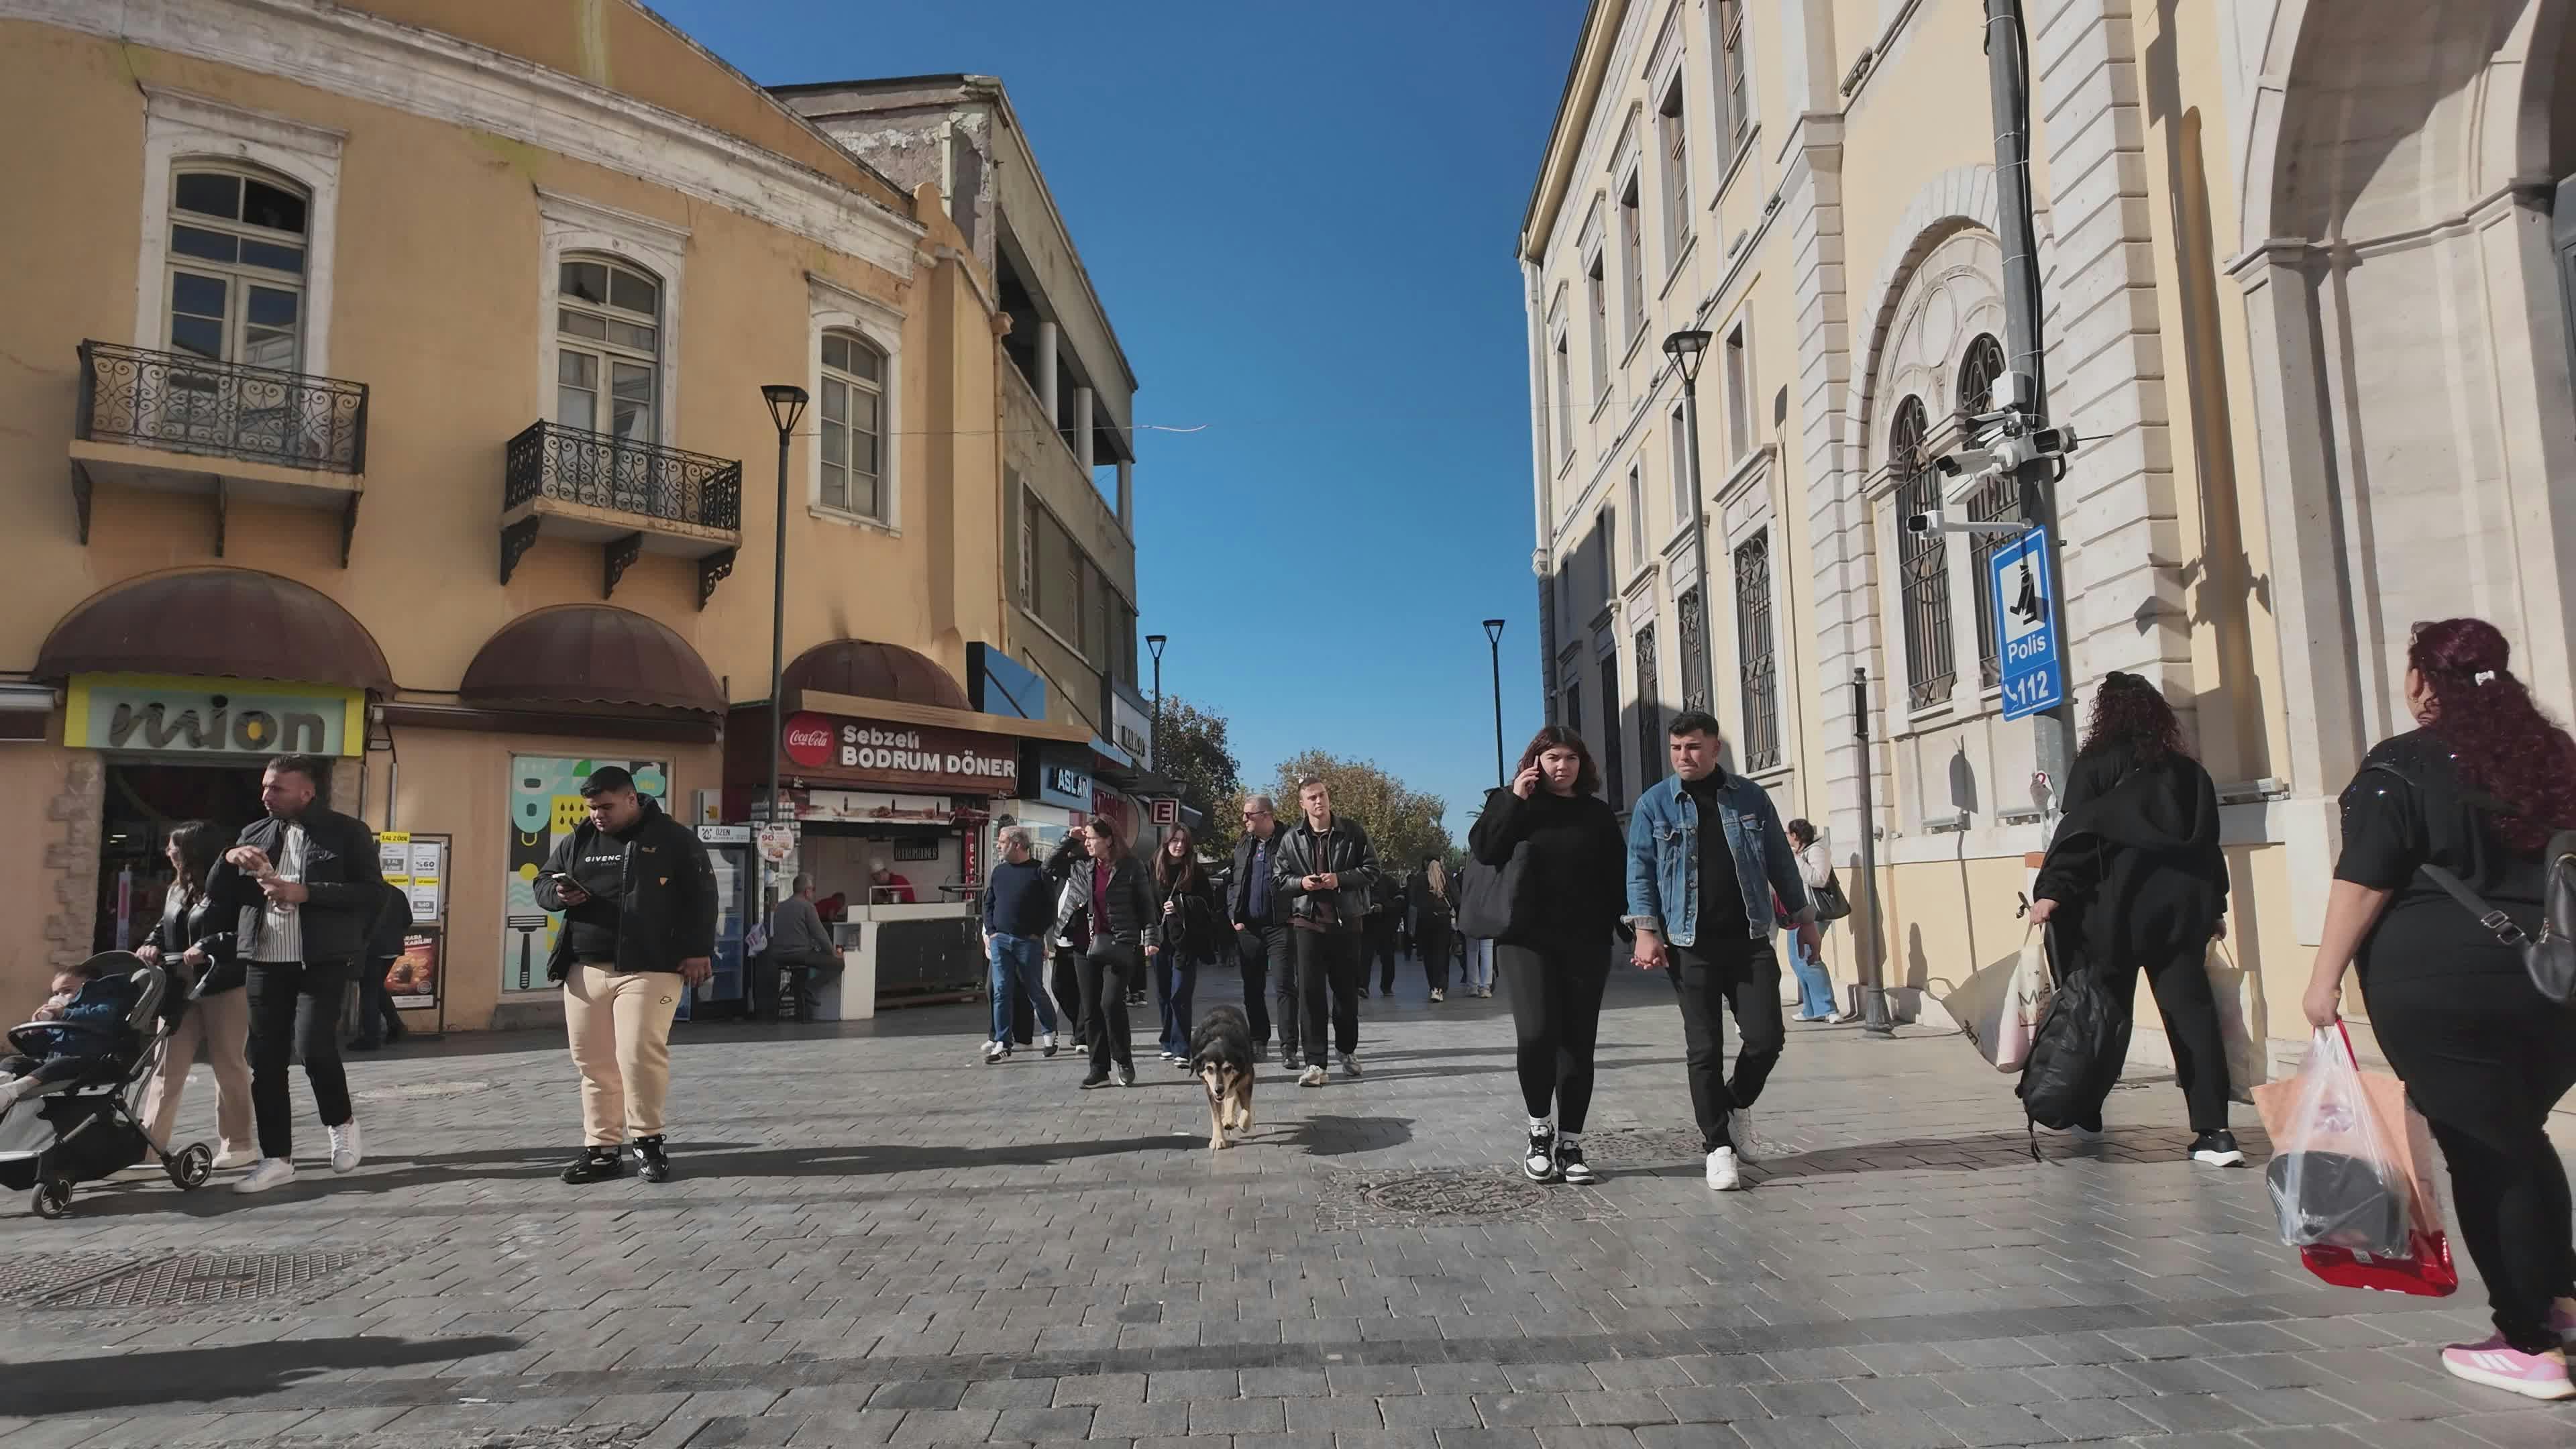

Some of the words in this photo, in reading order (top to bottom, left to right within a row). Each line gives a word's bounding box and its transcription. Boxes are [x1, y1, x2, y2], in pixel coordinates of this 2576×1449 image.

[2008, 634, 2046, 663] Polis
[2017, 670, 2049, 705] 112
[790, 729, 828, 747] Coca-Cola
[843, 724, 920, 749] Sebzeli
[842, 746, 941, 771] BODRUM
[947, 749, 1016, 777] DÖNER
[1057, 769, 1089, 798] ASLAN
[1157, 804, 1170, 820] E
